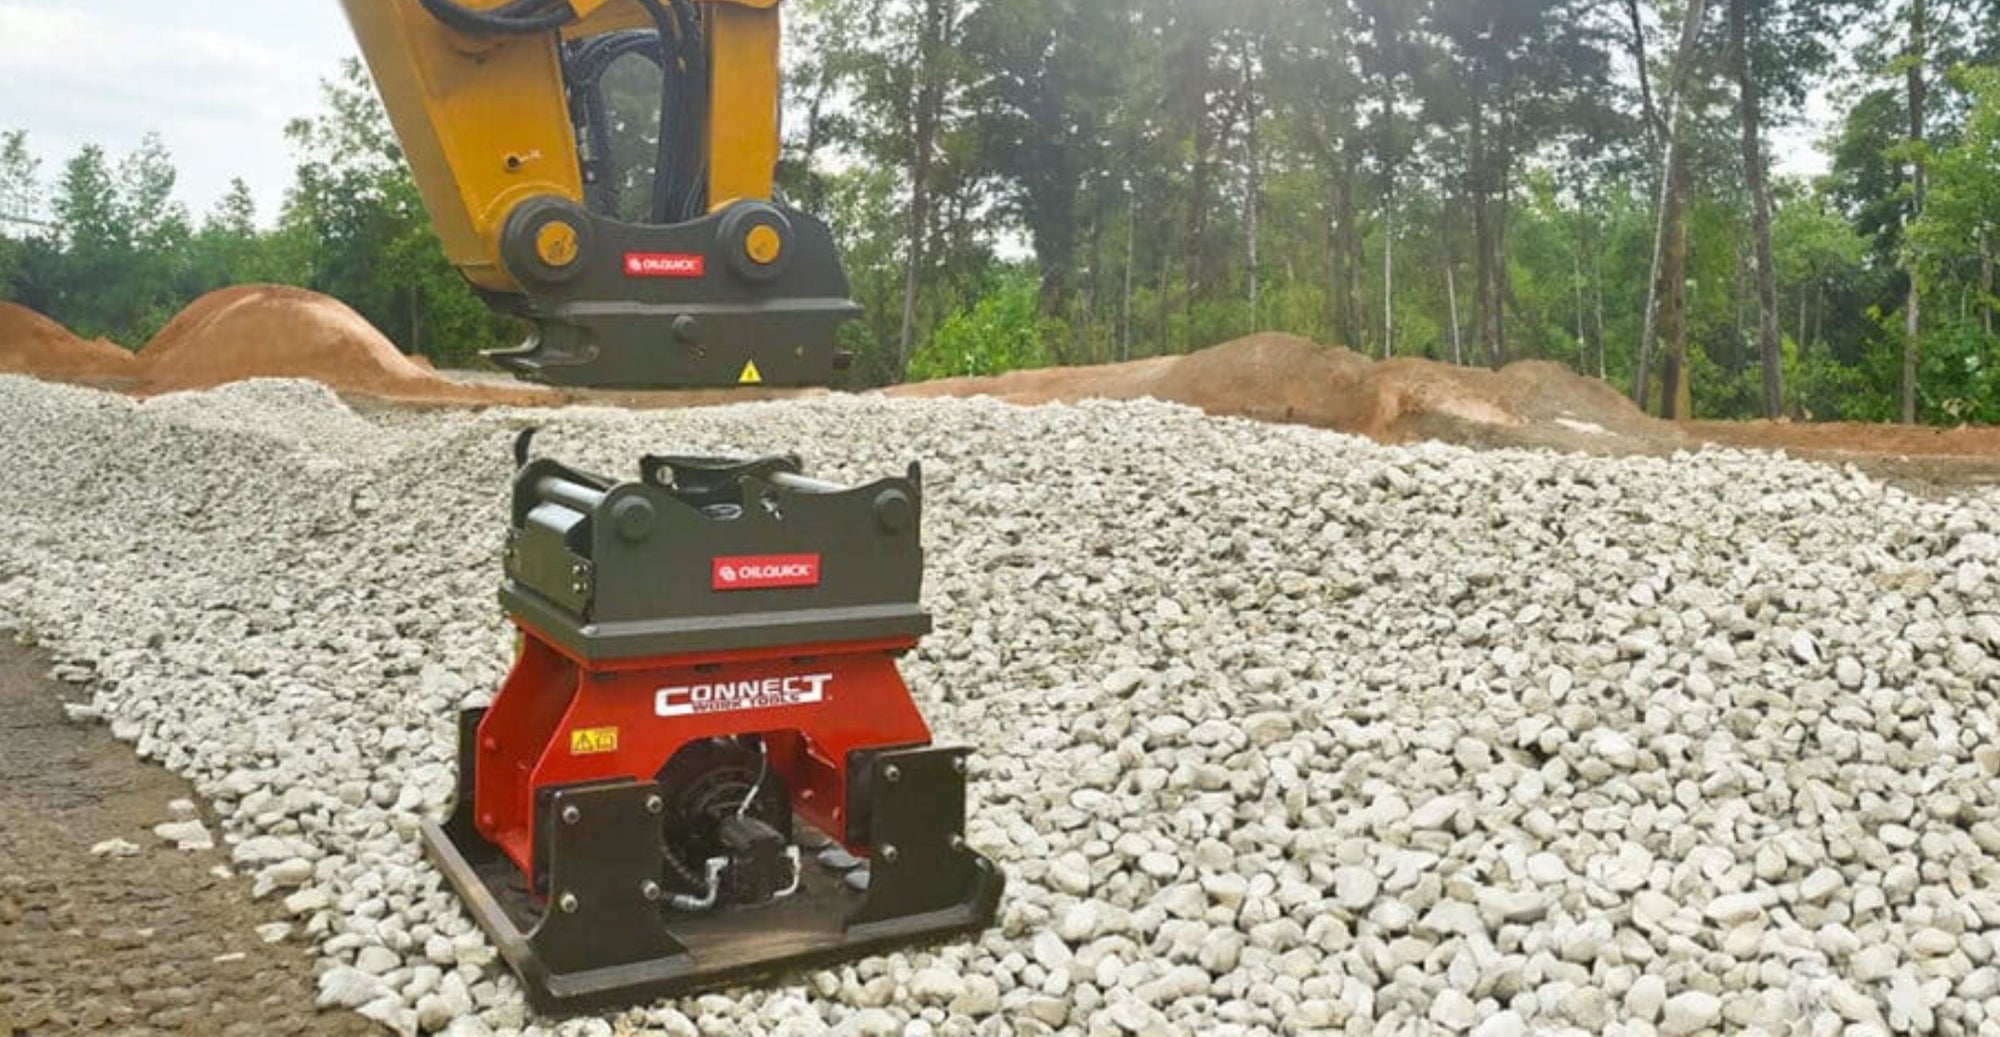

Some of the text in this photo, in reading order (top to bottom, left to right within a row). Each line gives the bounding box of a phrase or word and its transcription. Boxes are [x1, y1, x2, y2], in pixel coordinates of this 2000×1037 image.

[739, 564, 809, 579] OILQUICK
[655, 673, 833, 717] CONNECT
[692, 698, 742, 714] WORK
